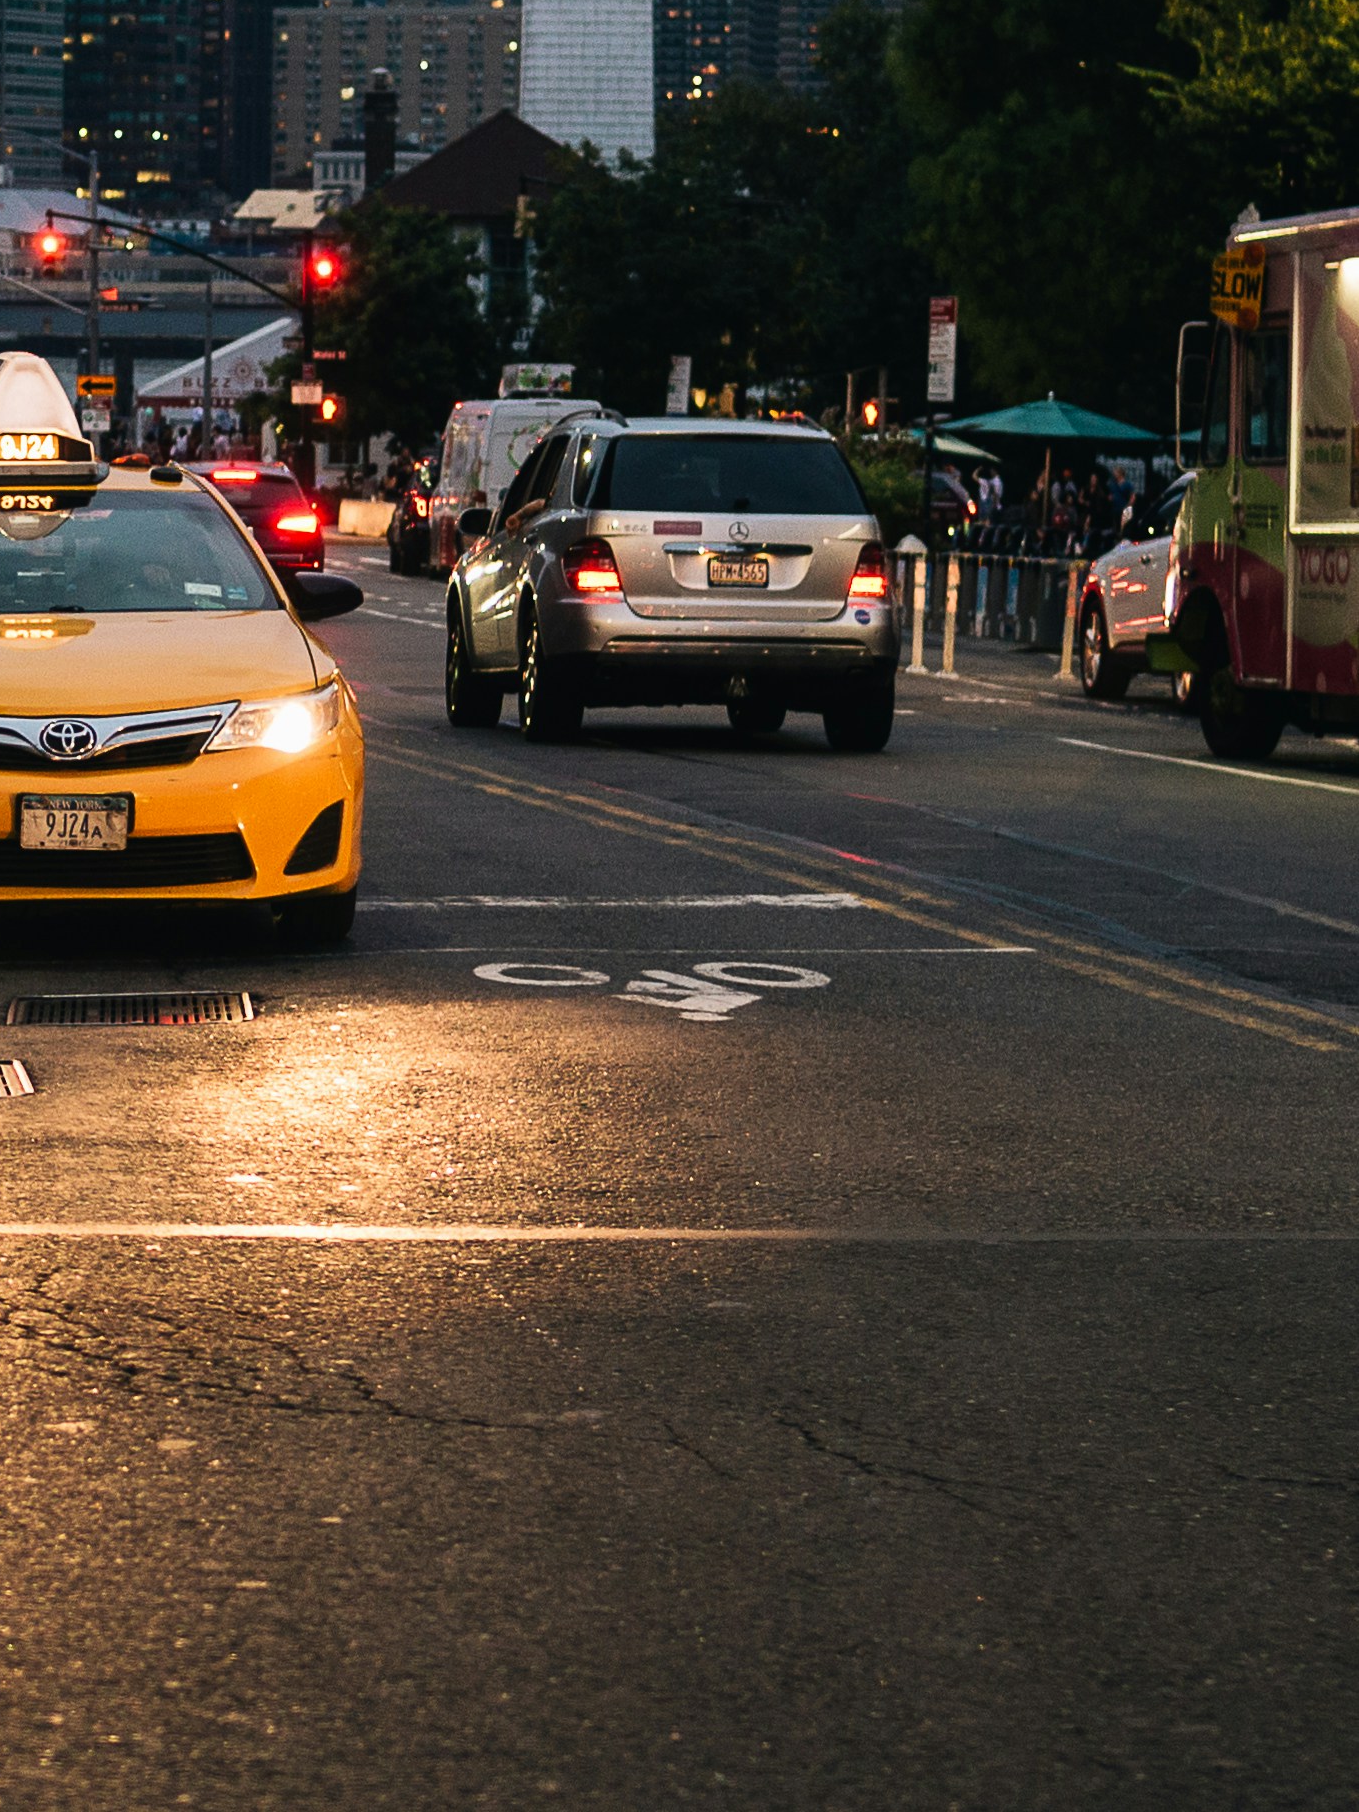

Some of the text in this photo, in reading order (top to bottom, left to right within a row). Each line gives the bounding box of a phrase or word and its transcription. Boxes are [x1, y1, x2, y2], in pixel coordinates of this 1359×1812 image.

[1212, 271, 1260, 299] SLOW
[183, 377, 231, 388] BUZZ
[0, 434, 55, 460] 9J24
[1299, 545, 1349, 585] YOGO
[49, 799, 102, 810] NEW YORK
[46, 813, 103, 838] 9J24A
